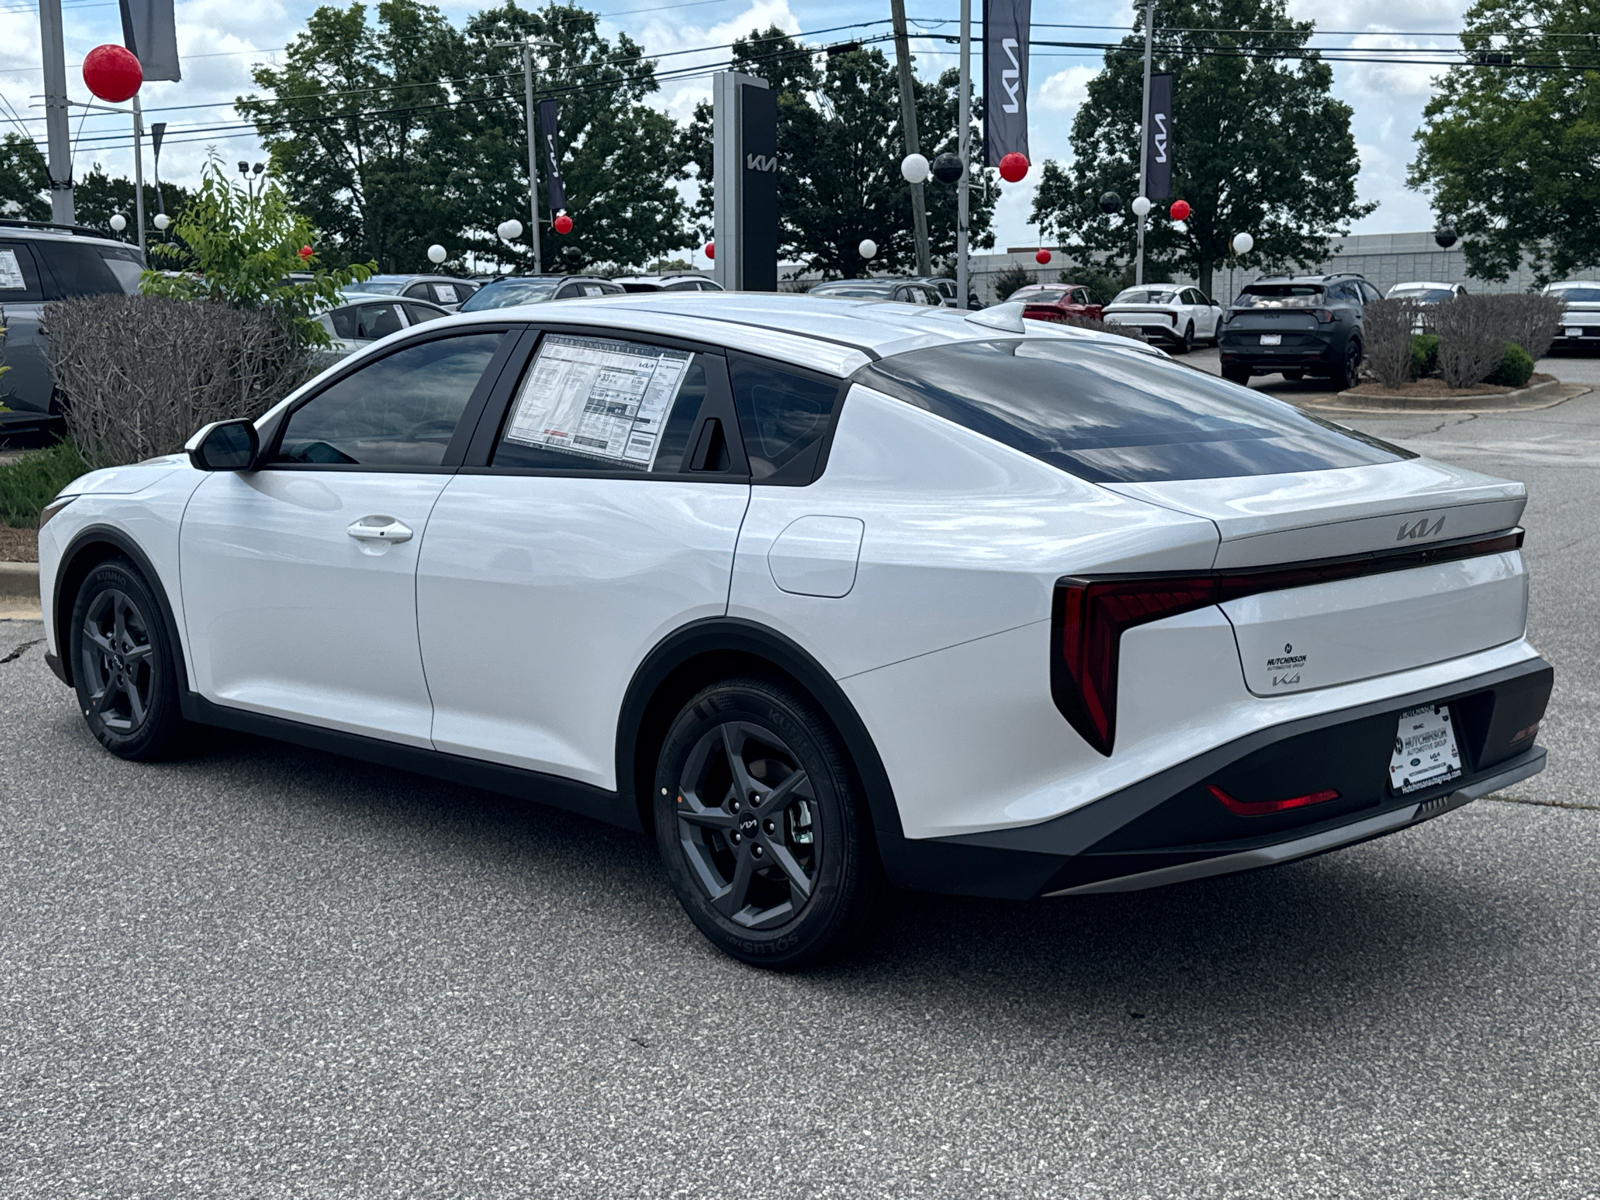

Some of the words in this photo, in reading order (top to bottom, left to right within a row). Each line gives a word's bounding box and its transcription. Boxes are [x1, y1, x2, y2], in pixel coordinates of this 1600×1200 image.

[1001, 38, 1020, 114] KIA
[1154, 113, 1167, 164] KIA
[746, 153, 777, 173] KIA
[1396, 515, 1446, 541] KIA
[96, 571, 127, 587] KUMHO
[1267, 655, 1307, 665] HUTCHINSON
[768, 708, 819, 774] KUMHO
[1404, 727, 1447, 749] HUTCHINSON
[739, 819, 758, 830] KIA
[743, 932, 800, 955] SOLUS
